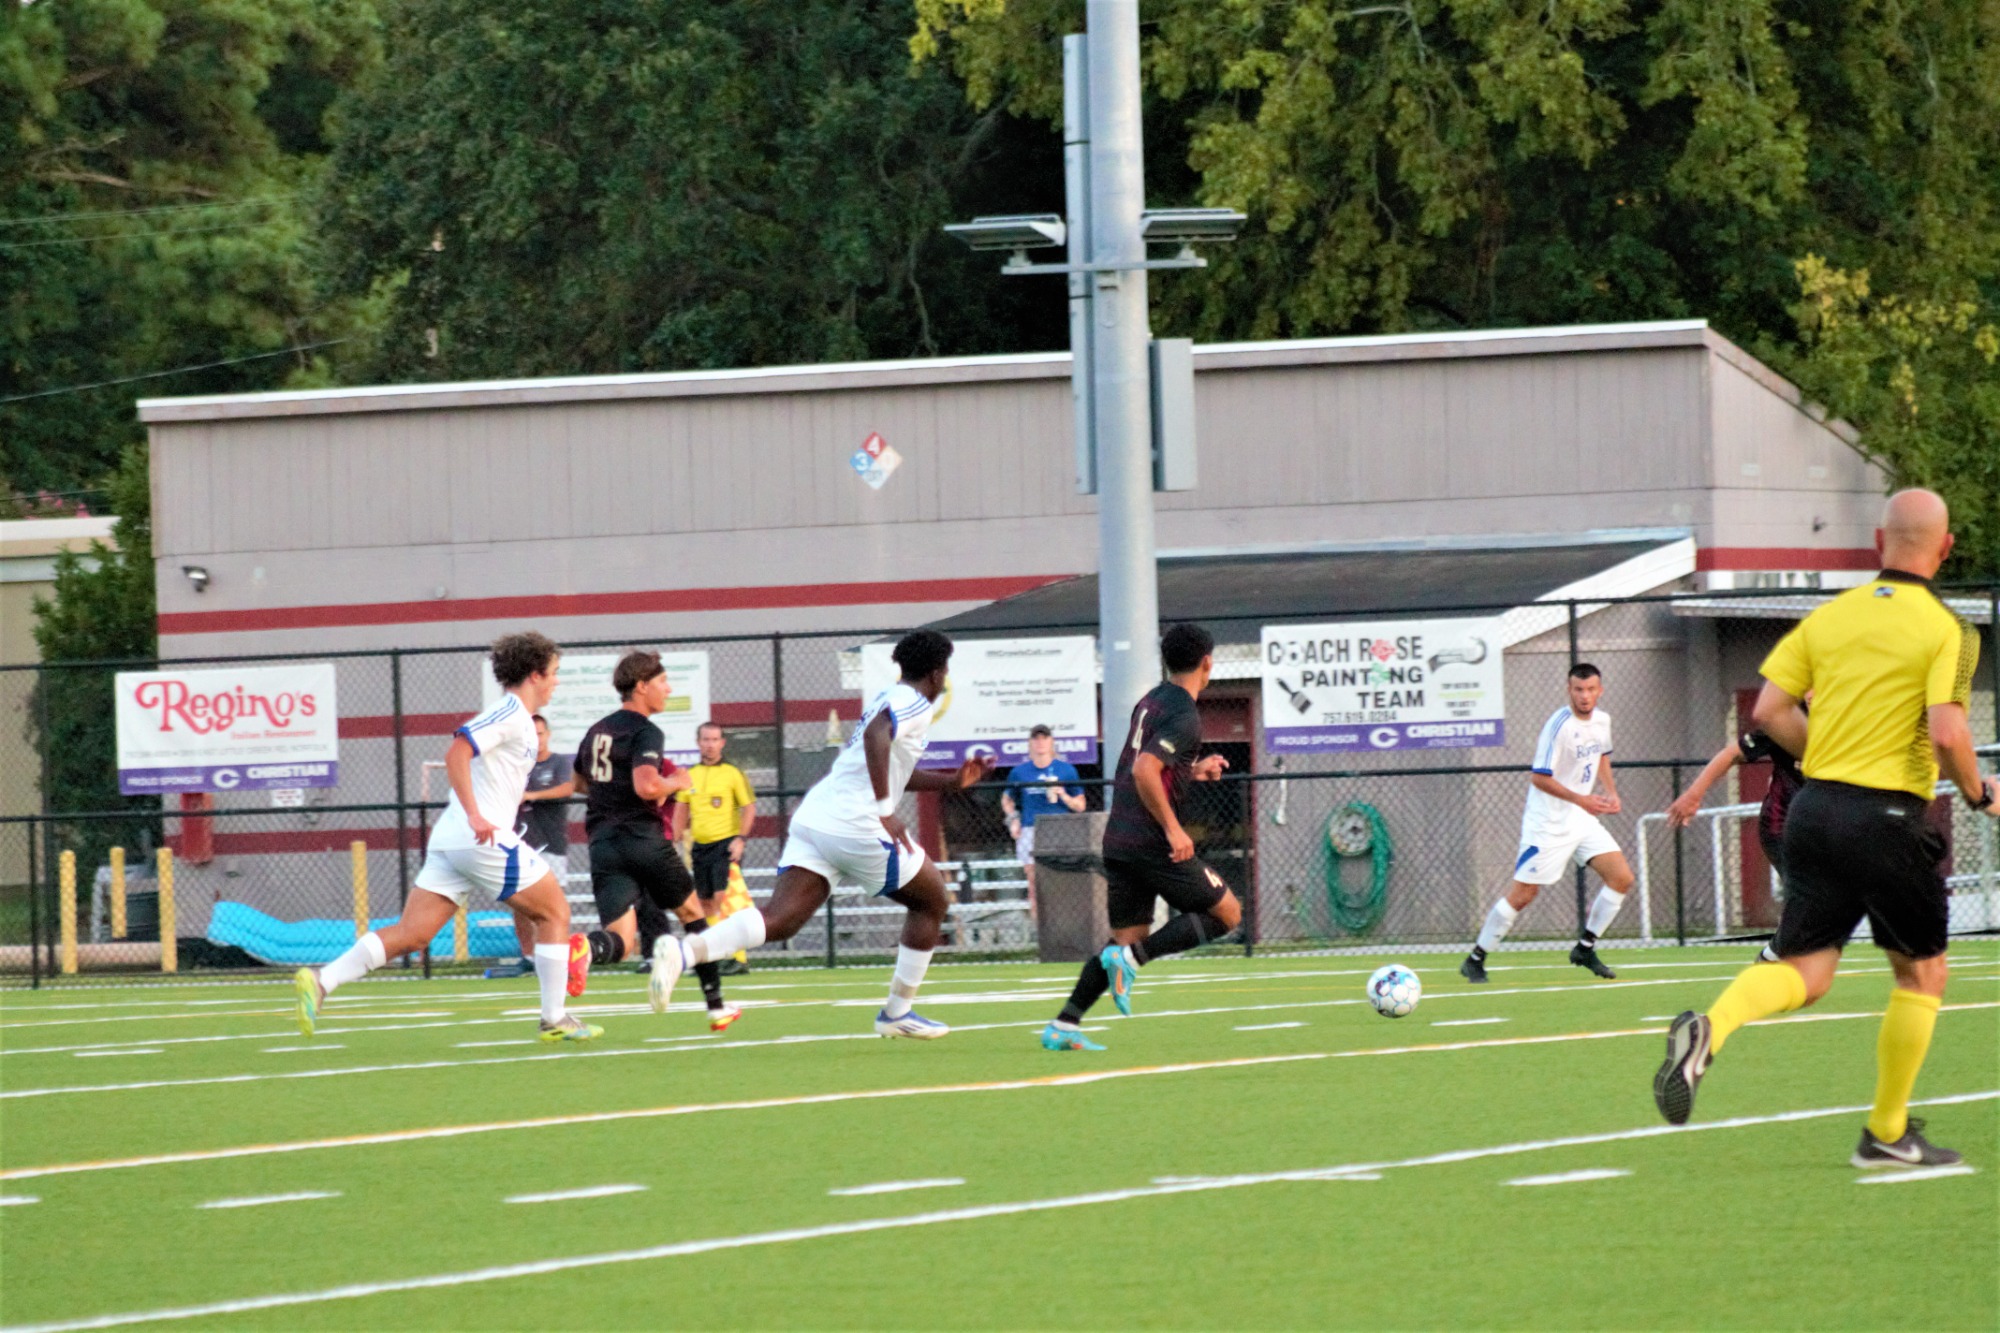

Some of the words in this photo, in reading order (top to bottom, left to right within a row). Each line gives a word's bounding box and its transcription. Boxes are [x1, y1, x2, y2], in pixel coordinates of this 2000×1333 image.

[135, 680, 316, 735] Regino's
[1357, 689, 1424, 709] TEAM
[1311, 734, 1359, 745] SPONSOR
[1368, 727, 1399, 748] C
[1406, 723, 1496, 739] CHRISTIAN
[590, 733, 613, 782] 13
[212, 769, 241, 789] C
